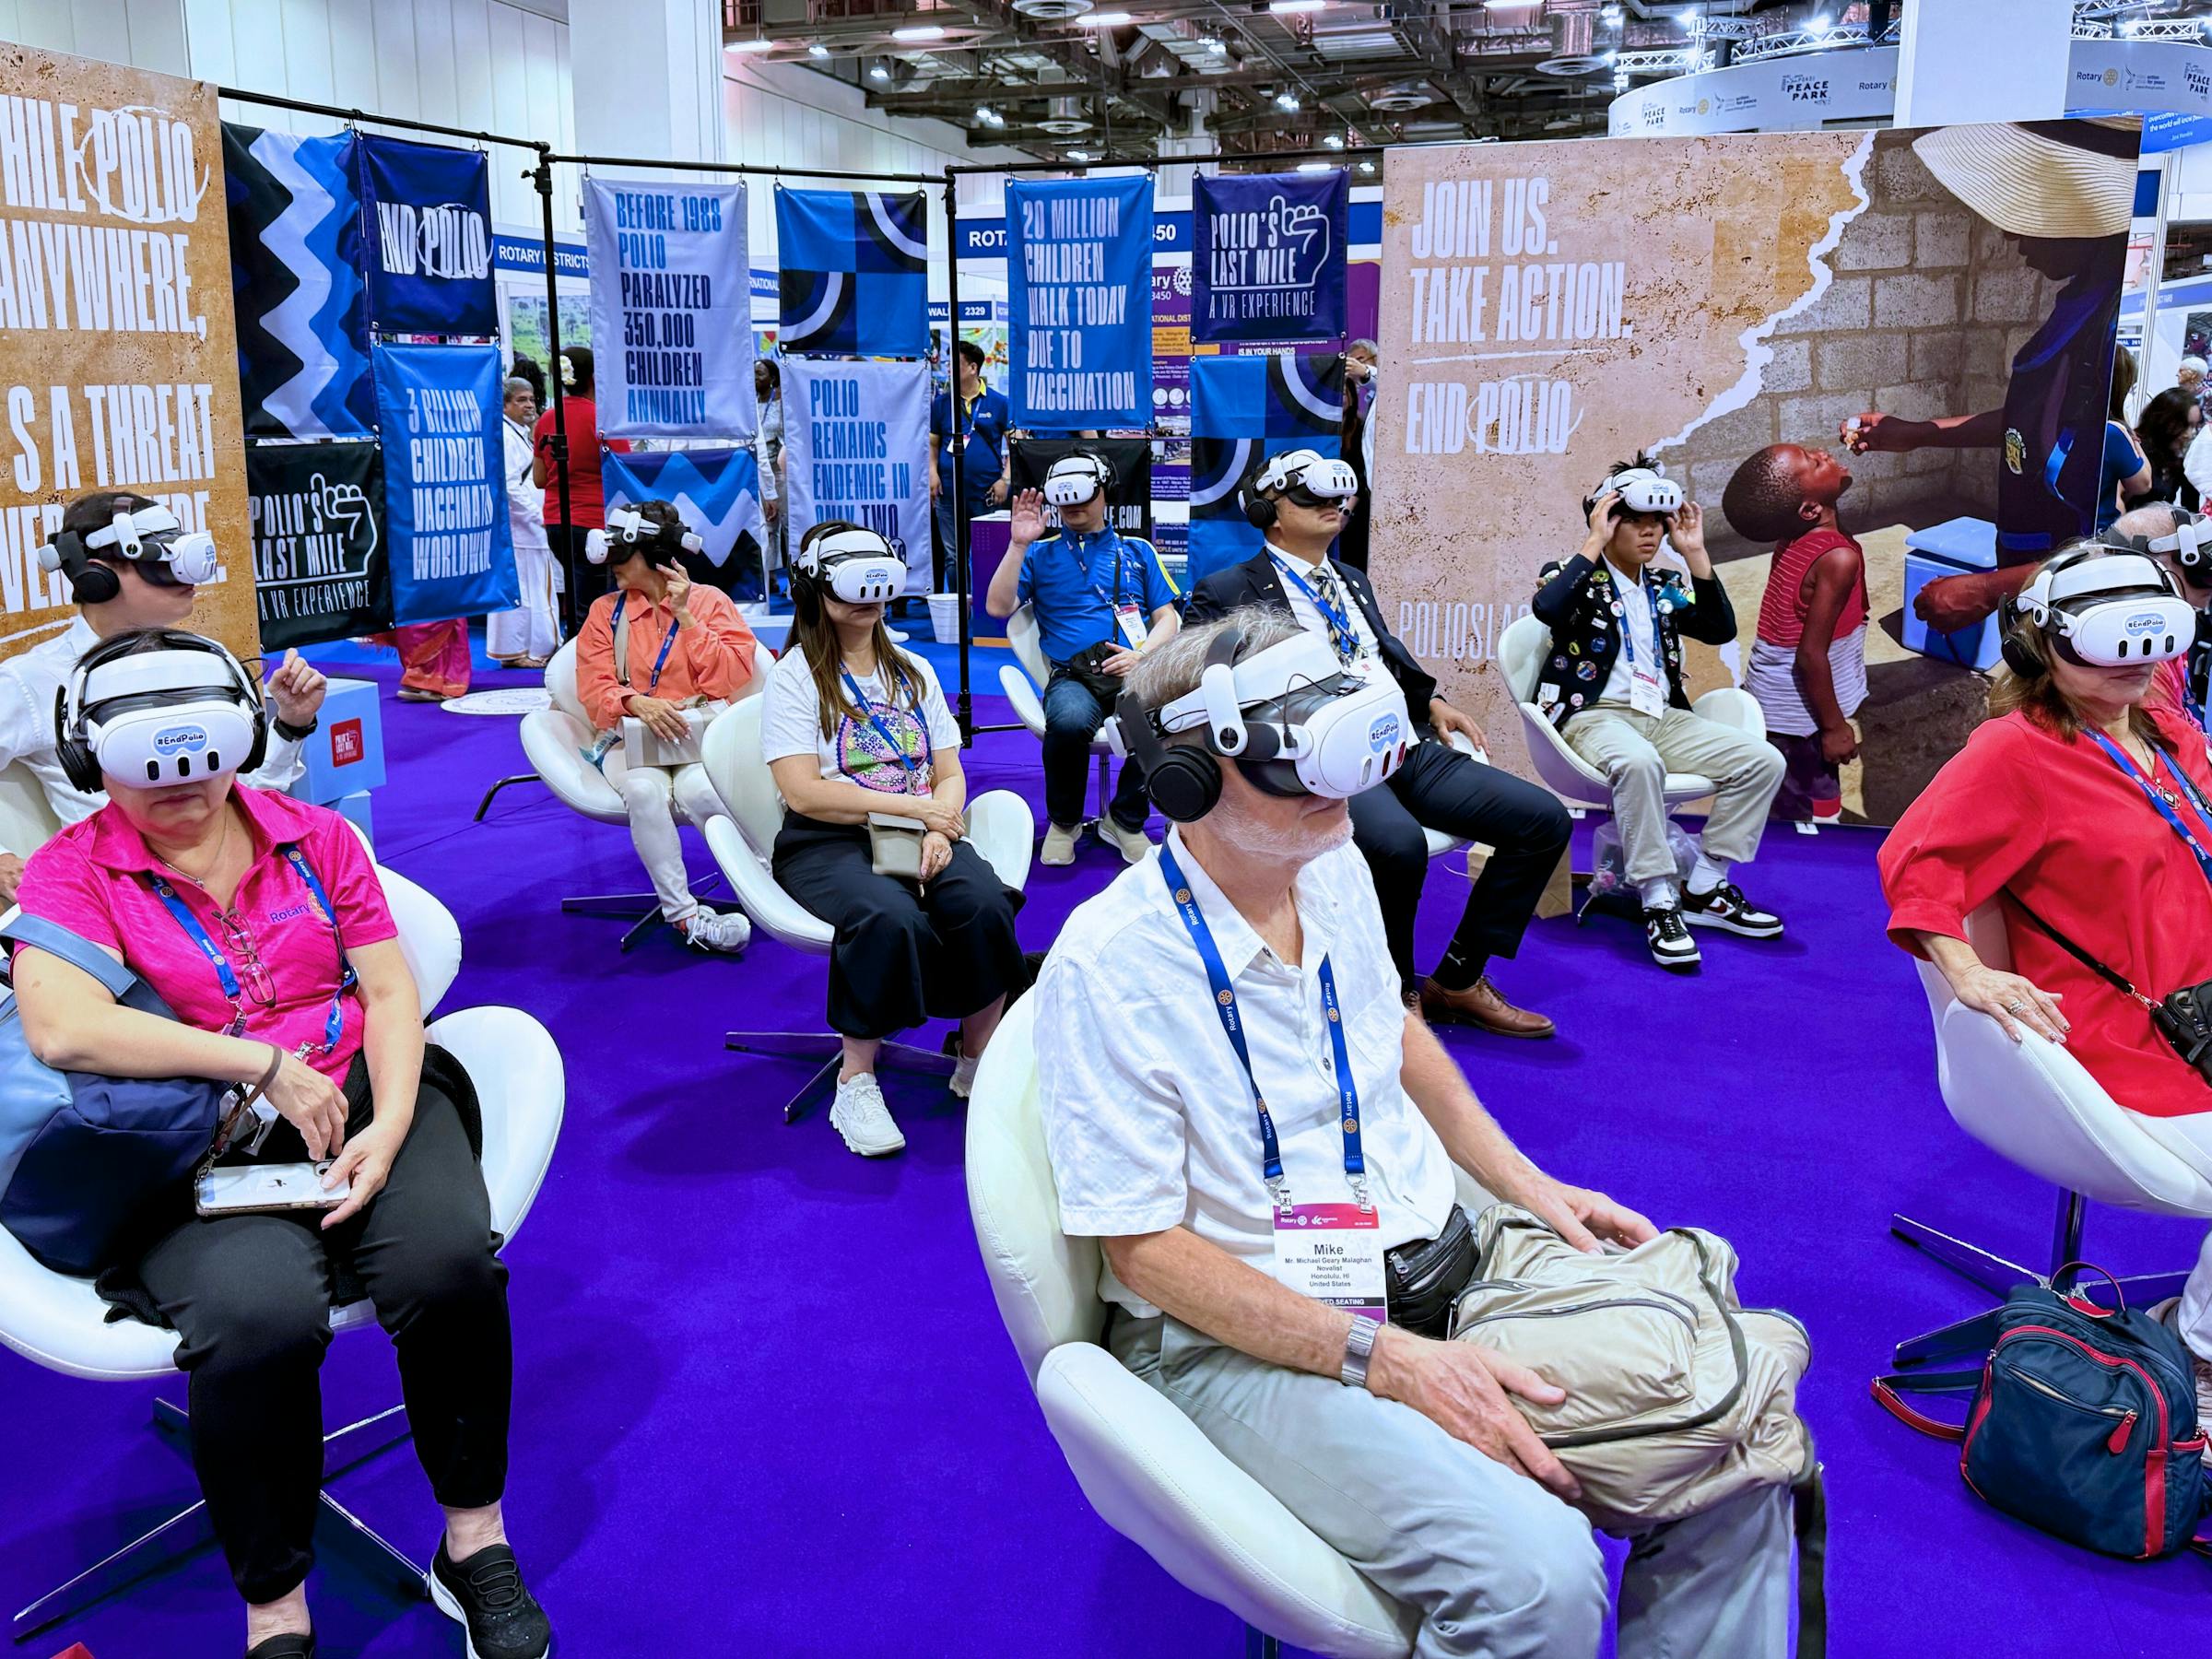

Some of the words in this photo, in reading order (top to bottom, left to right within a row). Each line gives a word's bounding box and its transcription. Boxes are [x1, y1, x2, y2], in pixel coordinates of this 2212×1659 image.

[1787, 81, 1830, 93] PEACE
[1792, 90, 1828, 101] PARK
[1858, 82, 1888, 90] Rotary
[2077, 71, 2101, 82] Rotary
[2187, 74, 2210, 86] PEACE
[2189, 83, 2208, 95] PARK
[90, 108, 197, 223] POLIO
[615, 192, 676, 230] BEFORE
[1023, 199, 1045, 240] 20
[1051, 196, 1120, 239] MILLION
[1411, 180, 1492, 258] JOIN
[1501, 177, 1558, 256] US.
[422, 206, 488, 279] POLIO
[969, 229, 1007, 247] ROT
[1210, 211, 1279, 250] POLIO'S
[499, 245, 541, 264] ROTARY
[618, 231, 666, 269] POLIO
[1024, 242, 1104, 283] CHILDREN
[1210, 251, 1249, 287] LAST
[1256, 247, 1297, 285] MILE
[620, 272, 711, 310] PARALYZED
[1028, 287, 1069, 326] WALK
[1076, 285, 1127, 324] TODAY
[1208, 294, 1216, 319] A
[1222, 293, 1236, 319] VR
[1241, 290, 1316, 318] EXPERIENCE
[1410, 266, 1489, 343] TAKE
[1496, 262, 1632, 341] ACTION.
[964, 306, 986, 316] 2329
[623, 312, 694, 349] 350,000
[1028, 329, 1053, 370] DUE
[1062, 329, 1082, 369] TO
[625, 349, 702, 387] CHILDREN
[627, 388, 706, 424] ANNUALLY
[810, 380, 858, 418] POLIO
[1026, 371, 1135, 411] VACCINATION
[406, 388, 418, 433] 3
[421, 389, 482, 432] BILLION
[1406, 382, 1467, 453] END
[1476, 381, 1571, 454] POLIO
[50, 385, 81, 490] A
[84, 383, 216, 487] THREAT
[812, 421, 887, 459] REMAINS
[410, 437, 485, 484] CHILDREN
[813, 464, 885, 500] ENDEMIC
[892, 463, 910, 500] IN
[249, 492, 324, 536] POLIO'S
[251, 537, 298, 581] LAST
[304, 532, 347, 576] MILE
[259, 592, 268, 620] A
[270, 590, 289, 619] VR
[293, 580, 371, 616] EXPERIENCE
[1398, 601, 1531, 660] POLIOSLA
[158, 734, 204, 746] #EndPolio
[270, 904, 311, 923] Rotary
[1185, 903, 1200, 926] Rotary
[1324, 982, 1334, 1006] Rotary
[1226, 1006, 1237, 1031] Rotary
[1345, 1091, 1353, 1117] Rotary
[1313, 1243, 1344, 1255] Mike
